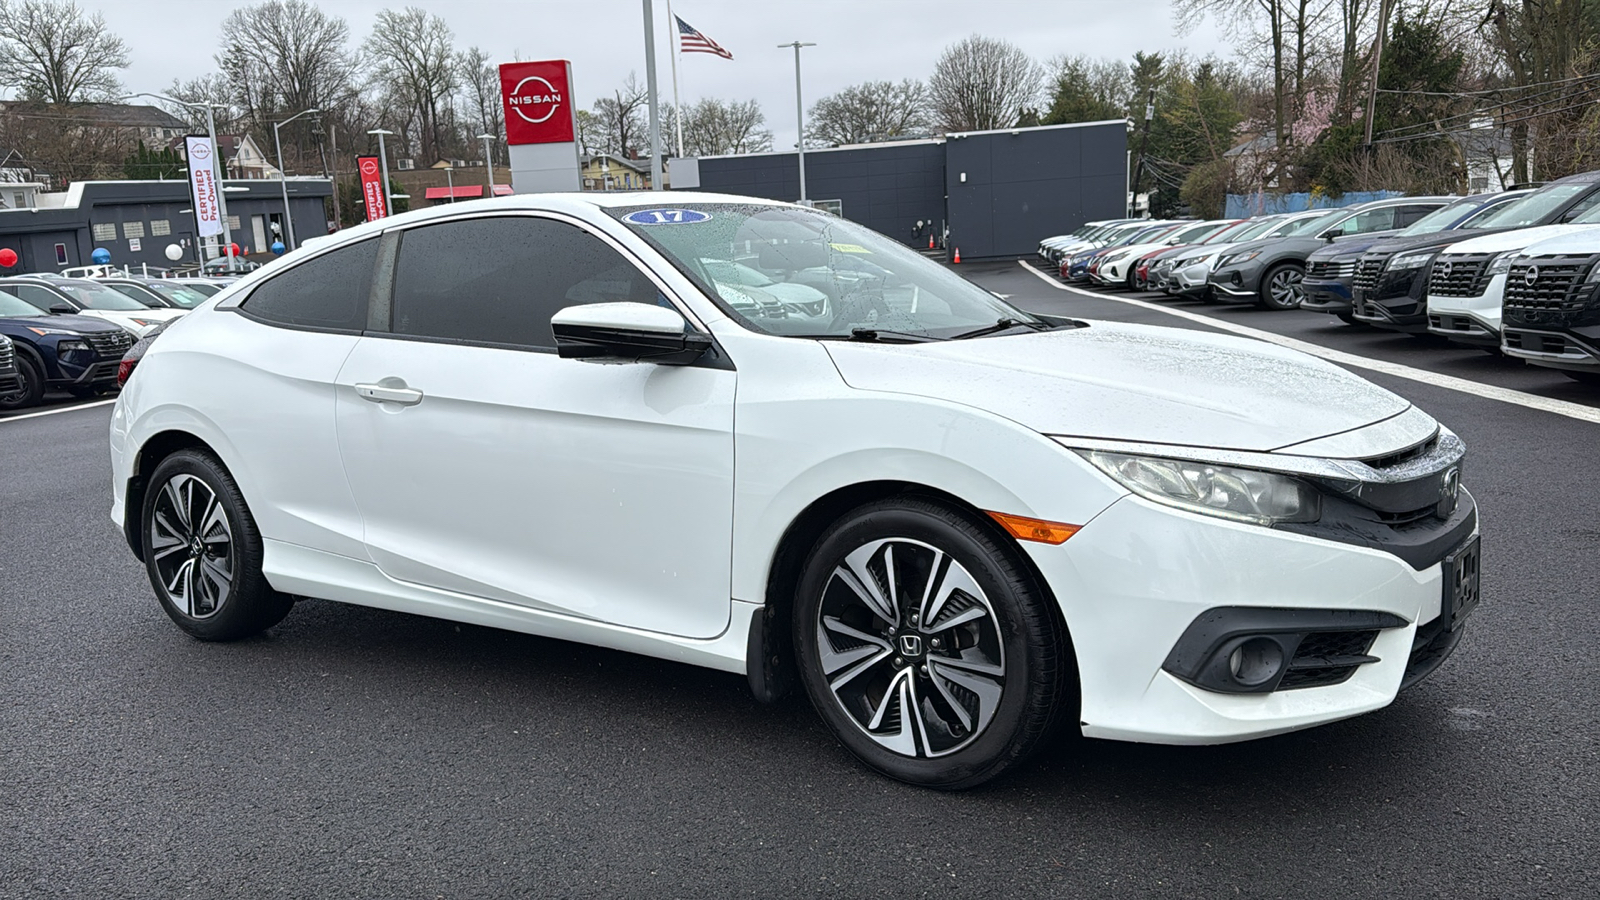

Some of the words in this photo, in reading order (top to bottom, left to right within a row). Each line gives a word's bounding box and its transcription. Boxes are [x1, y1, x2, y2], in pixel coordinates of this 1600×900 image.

[509, 94, 561, 105] NISSAN
[195, 169, 209, 222] CERTIFIED
[203, 169, 217, 221] Pre-Owned
[372, 181, 384, 218] re-Owned
[650, 211, 682, 222] 17
